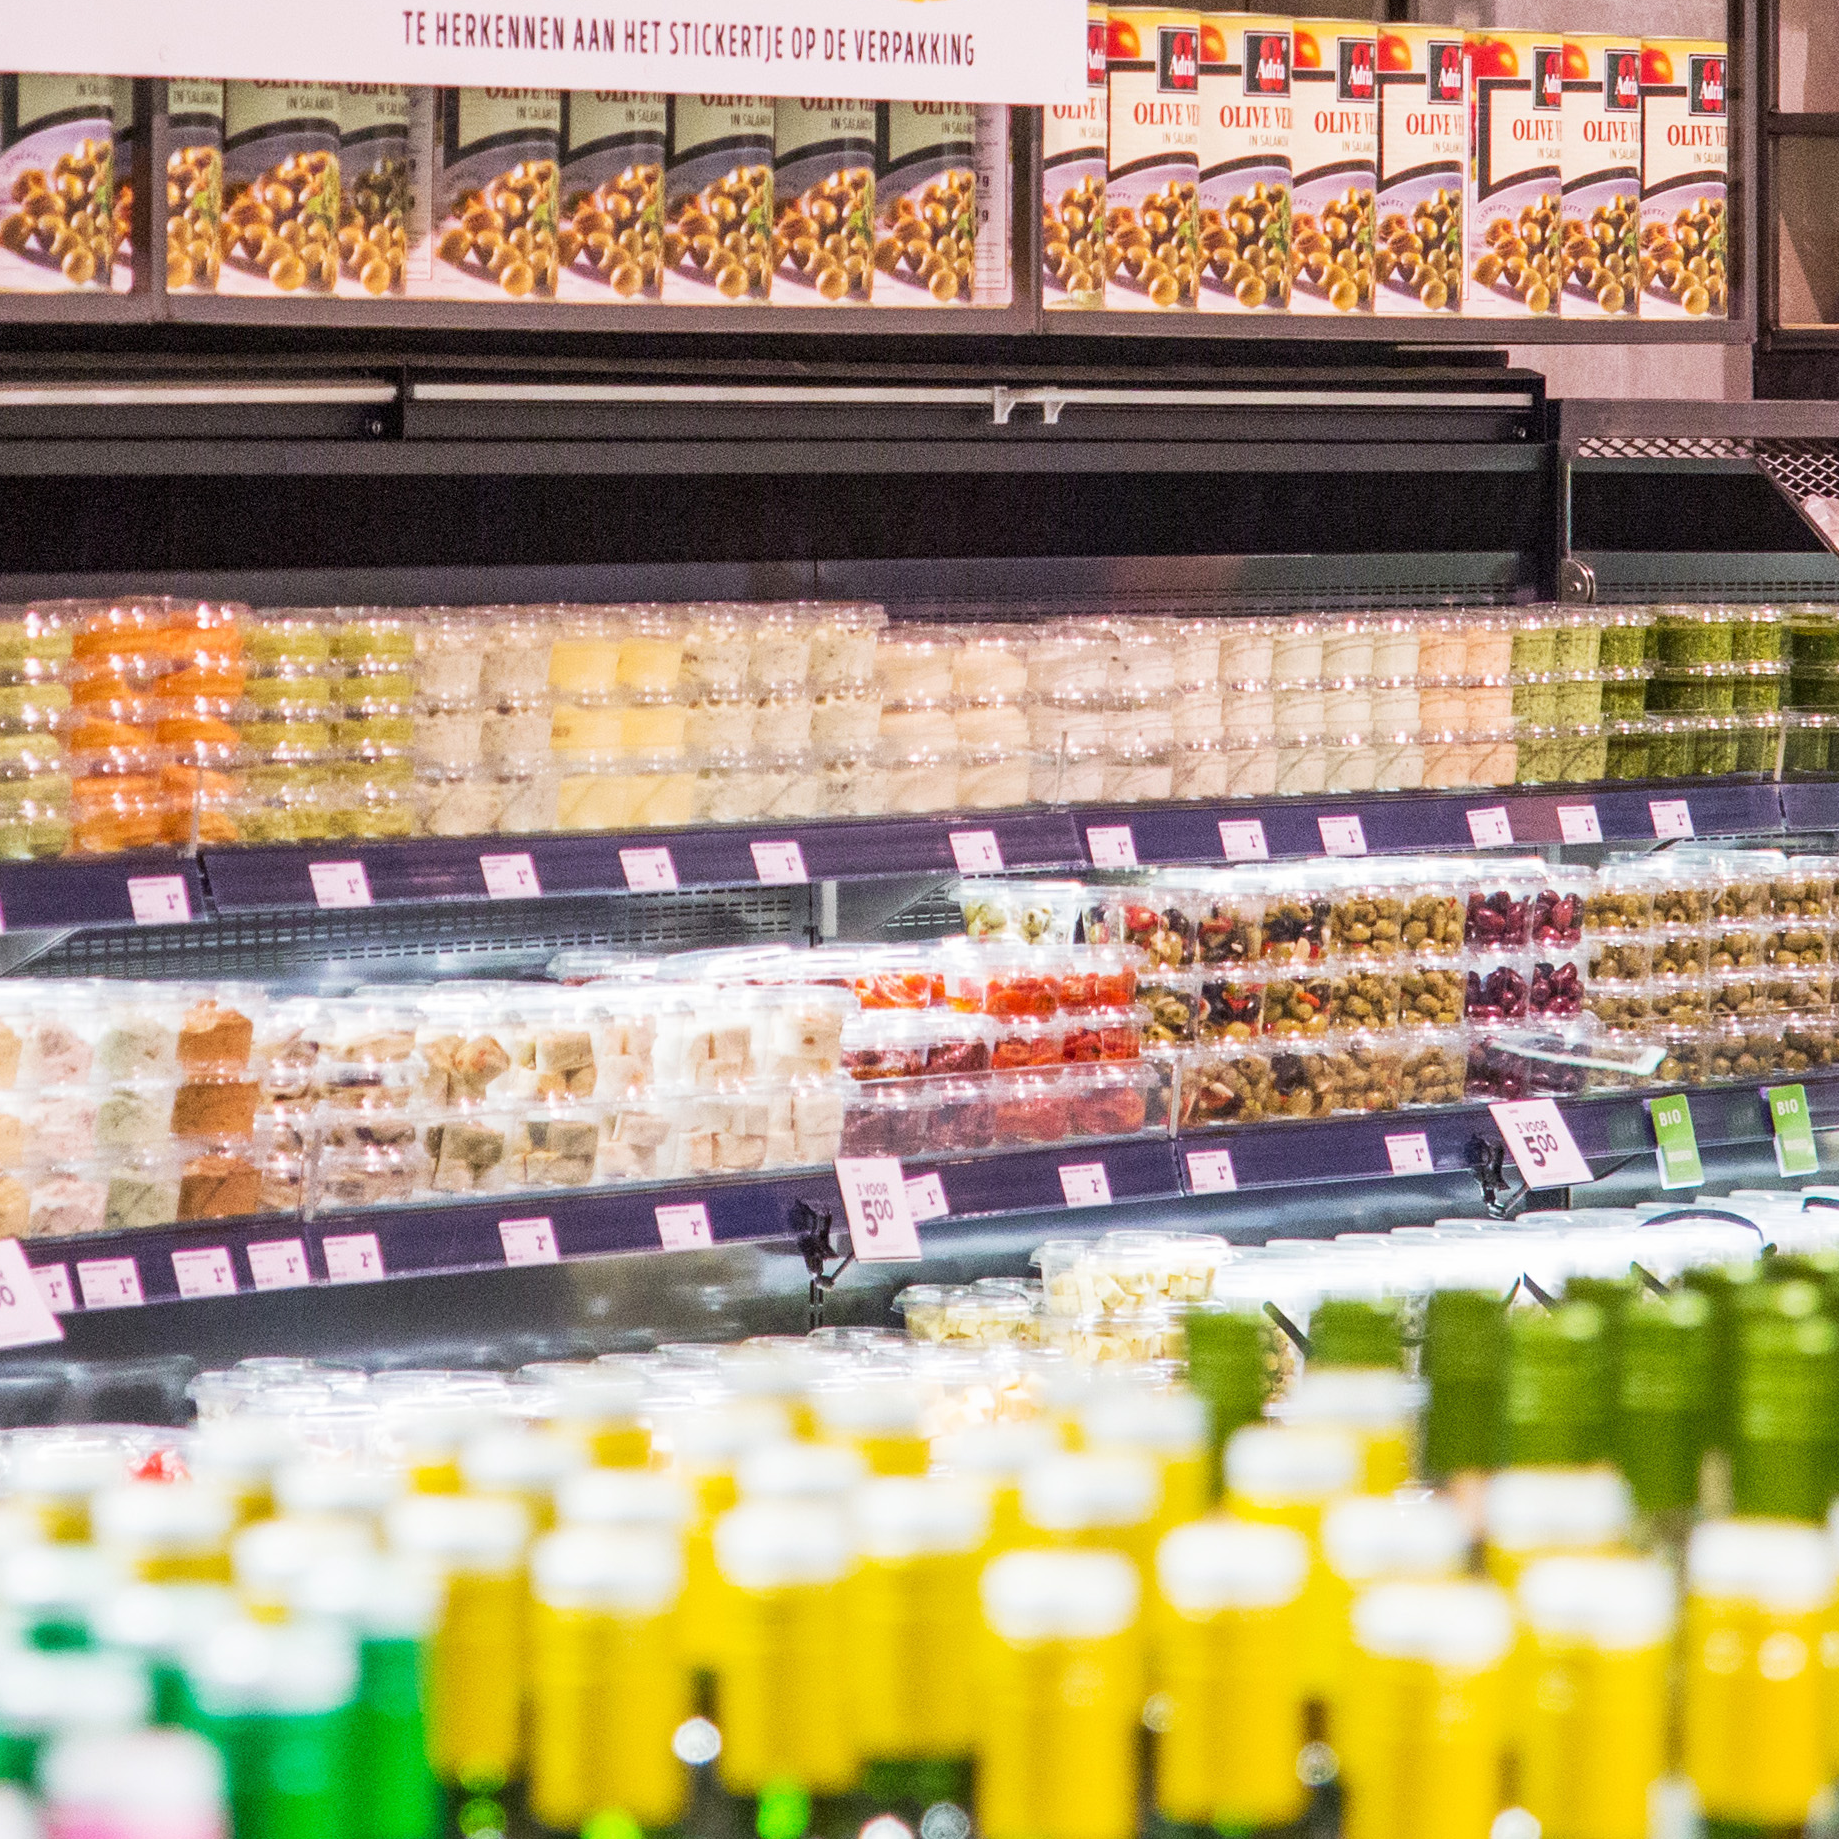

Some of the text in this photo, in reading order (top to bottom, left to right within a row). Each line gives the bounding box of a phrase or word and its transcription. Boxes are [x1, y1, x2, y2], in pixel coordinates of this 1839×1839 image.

[402, 11, 975, 67] TE HERKENNEN AAN HET STICKERTJE OP DE VERPAKKING
[1255, 56, 1286, 80] Adria
[1133, 101, 1180, 126] OLIVE
[1219, 105, 1271, 129] OLIVE
[1314, 110, 1362, 134] OLIVE
[1406, 112, 1452, 136] OLIVE
[1512, 118, 1555, 141] OLIVE
[1583, 120, 1628, 143] OLIVE
[1666, 123, 1713, 147] OLIVE
[1658, 1109, 1682, 1127] BIO
[1776, 1098, 1799, 1115] BIO
[1522, 1120, 1550, 1132] VOOR
[863, 1182, 889, 1196] VOOR
